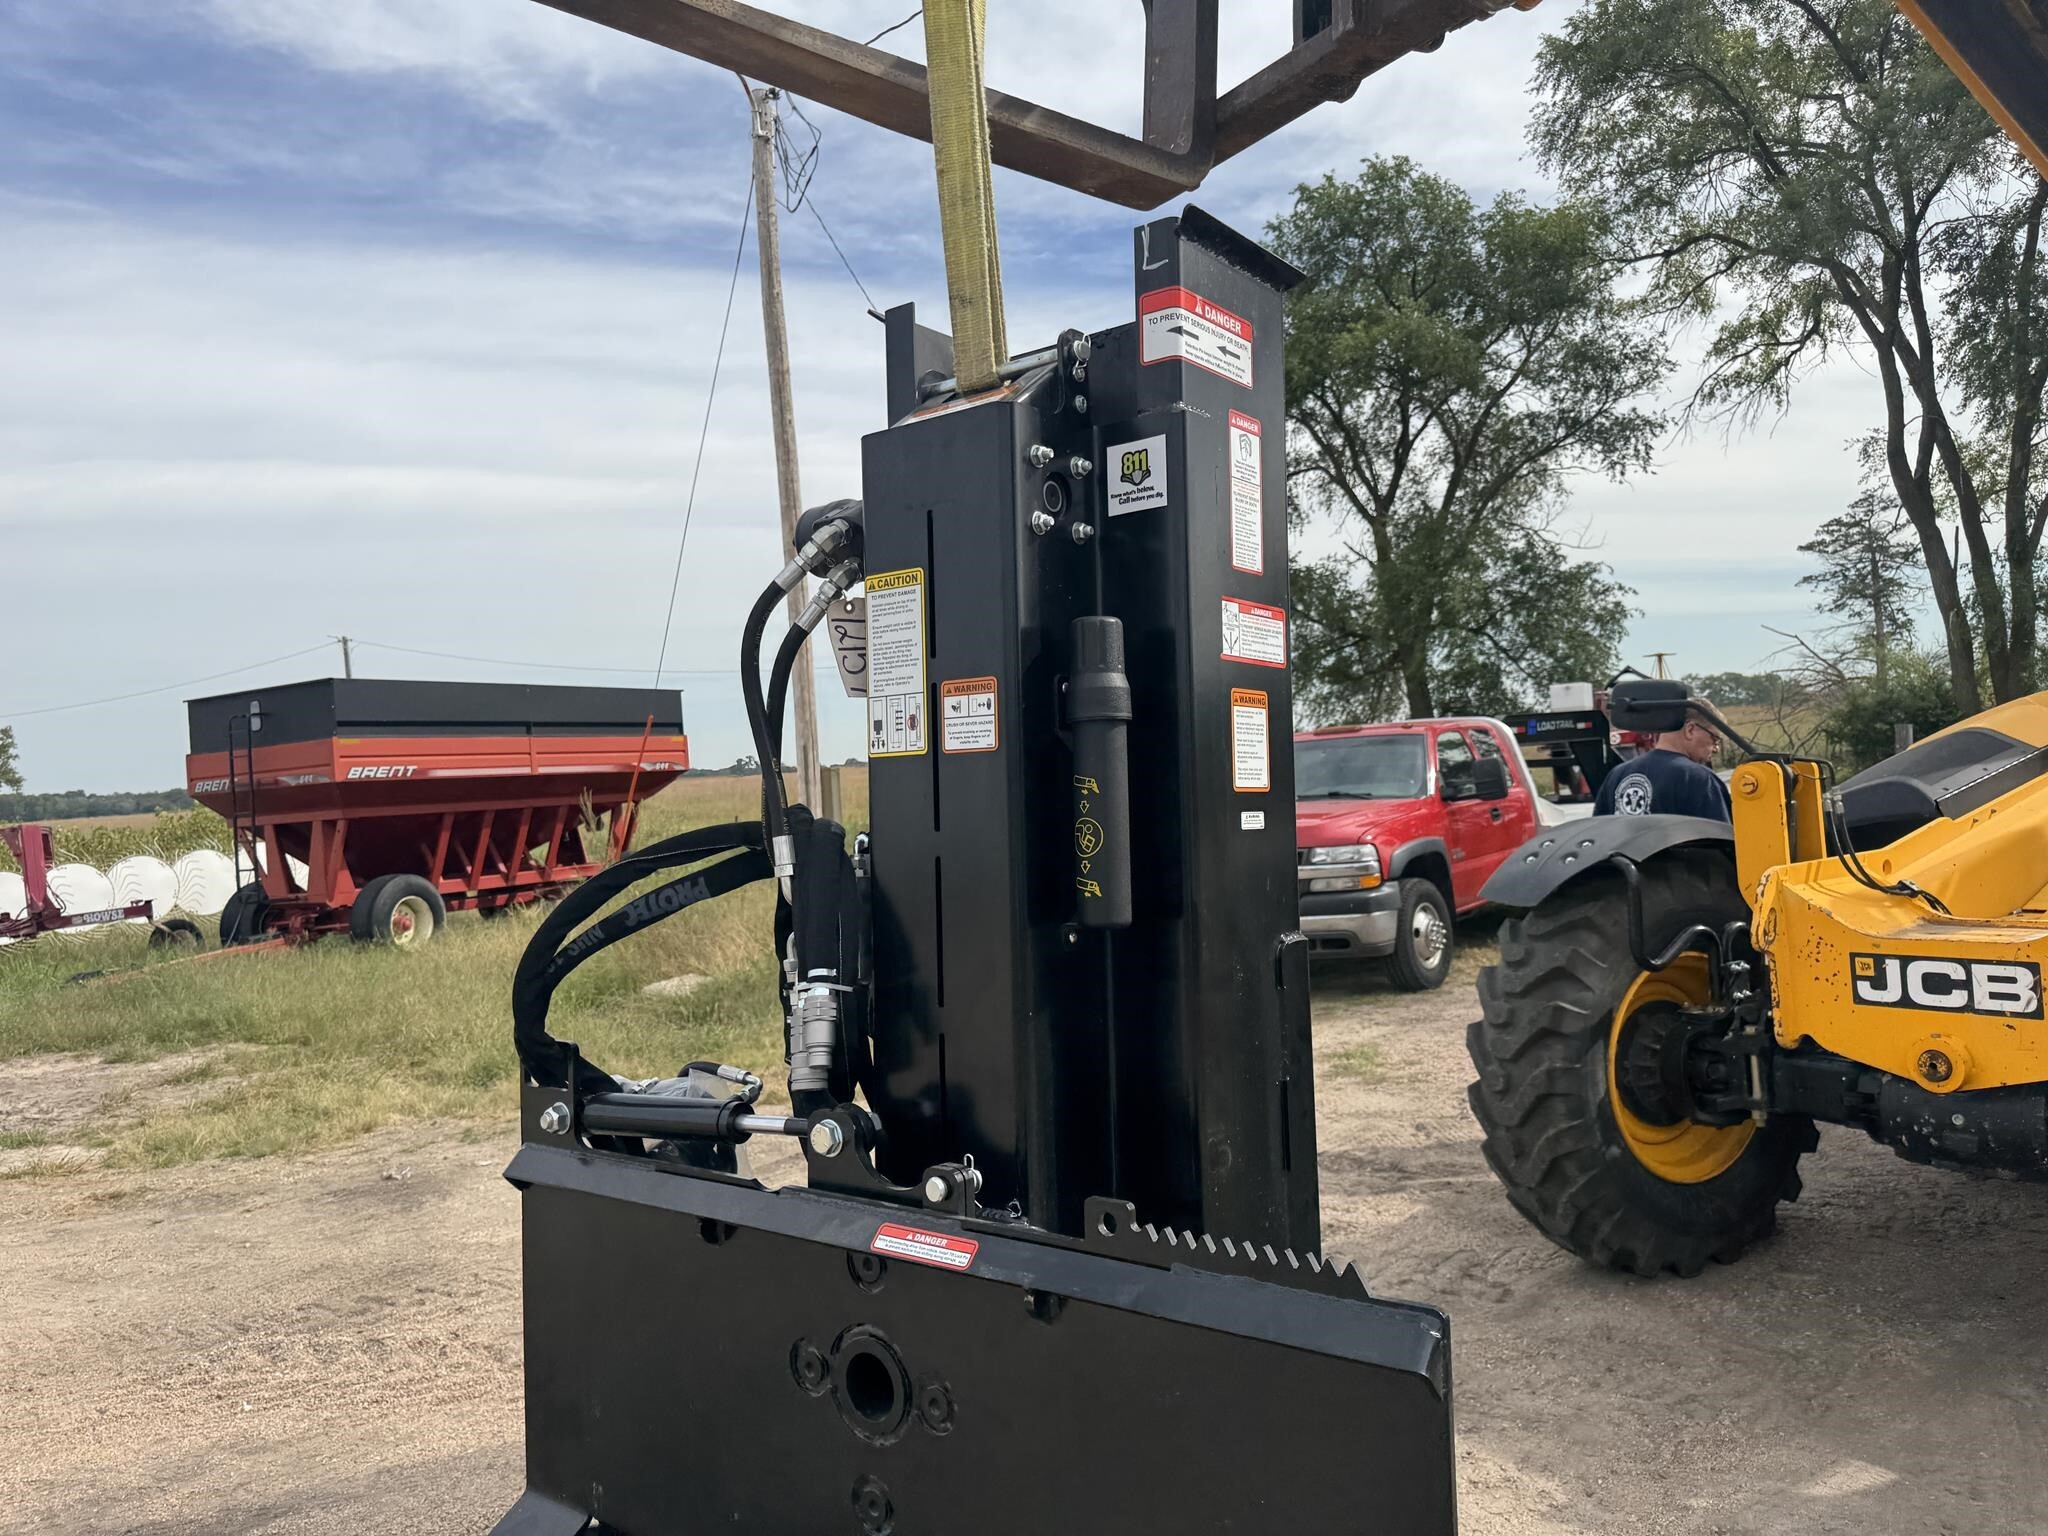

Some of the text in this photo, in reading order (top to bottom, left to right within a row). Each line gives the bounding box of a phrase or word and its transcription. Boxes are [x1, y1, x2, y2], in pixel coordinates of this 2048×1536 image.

[1205, 305, 1241, 335] DANGER
[1148, 317, 1158, 326] TO
[1160, 312, 1190, 324] PREVENT
[1190, 318, 1211, 333] SERIOUS
[1211, 328, 1227, 342] INJURY
[1226, 336, 1234, 345] OR
[1236, 417, 1259, 433] DANGER
[1121, 448, 1149, 475] 811
[1118, 496, 1131, 505] Call
[1131, 495, 1146, 503] before
[1146, 493, 1155, 501] you
[877, 573, 918, 589] CAUTION
[898, 588, 916, 596] DAMAGE
[1254, 608, 1273, 618] DANGER
[953, 682, 992, 693] WARNING
[1238, 695, 1266, 706] WARNING
[347, 765, 418, 779] BRENT
[620, 876, 712, 927] PROTEC
[1856, 958, 2038, 1013] JCB
[914, 1233, 947, 1247] DANGER
